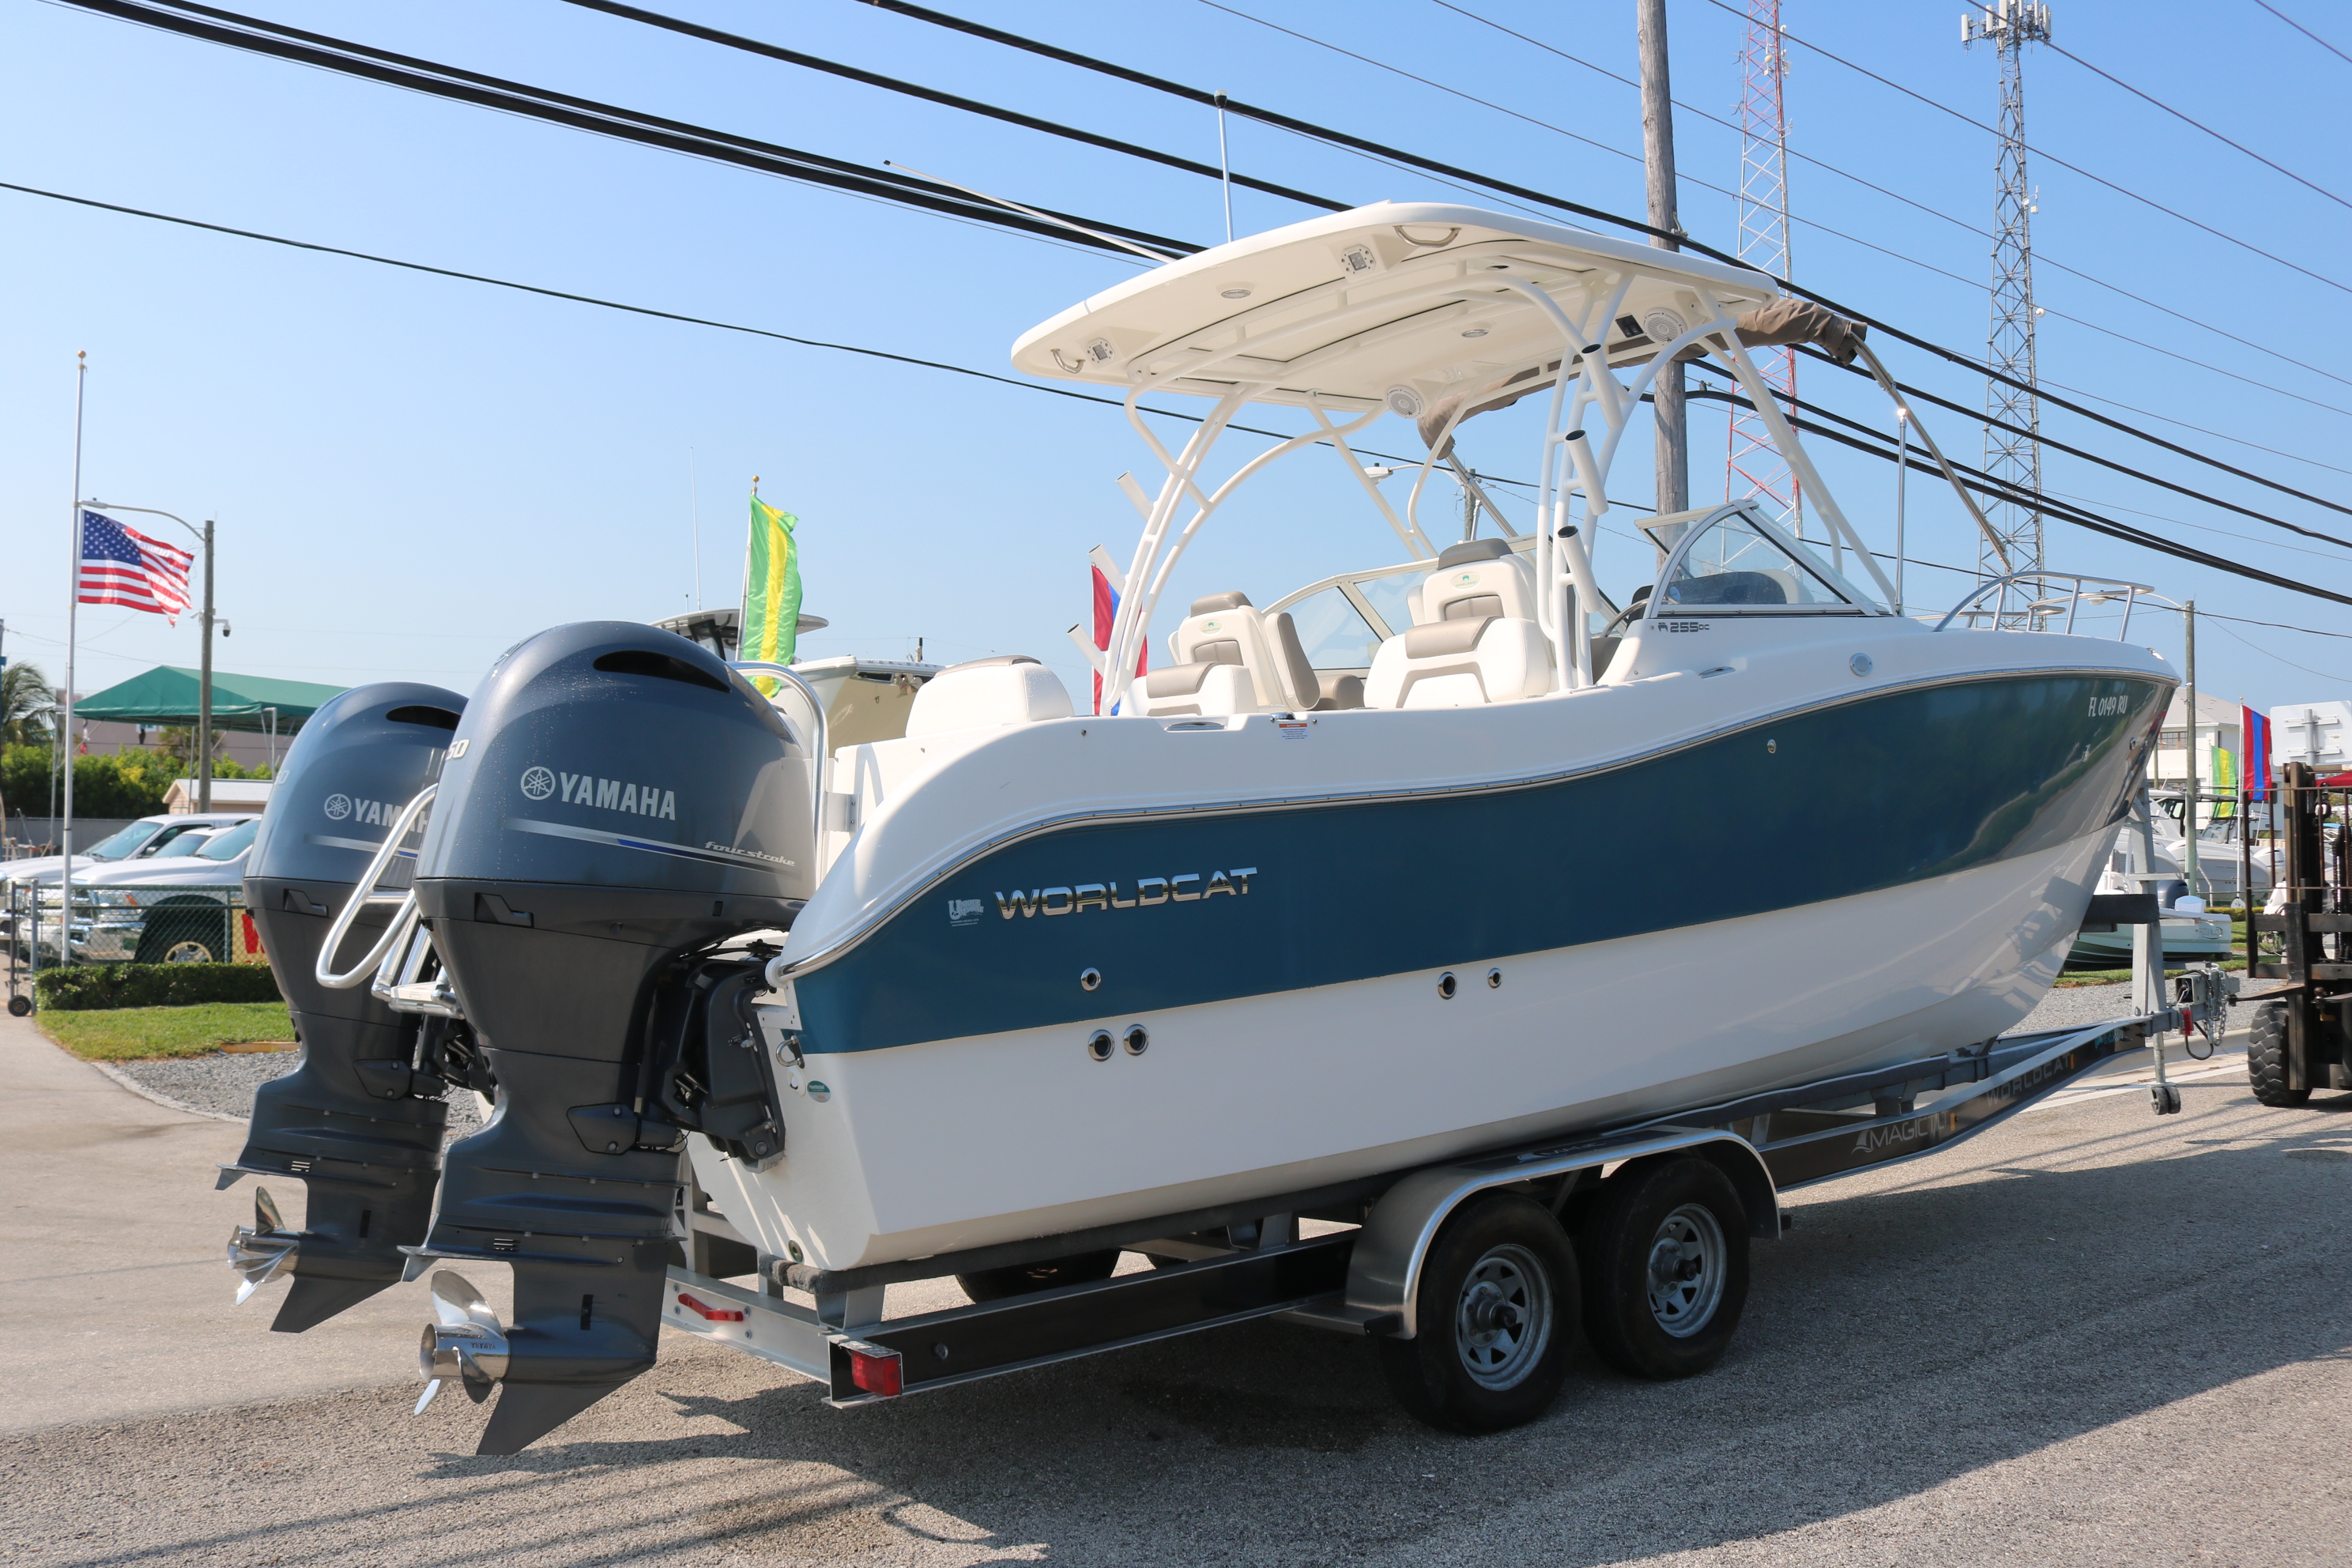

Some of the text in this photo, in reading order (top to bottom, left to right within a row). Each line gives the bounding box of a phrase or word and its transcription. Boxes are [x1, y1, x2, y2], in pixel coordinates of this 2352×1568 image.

[2088, 696, 2098, 718] FL
[2117, 695, 2128, 714] RU
[560, 771, 676, 820] YAMAHA
[993, 867, 1258, 920] WORLDCAT
[1986, 1051, 2071, 1107] WORLDCAT
